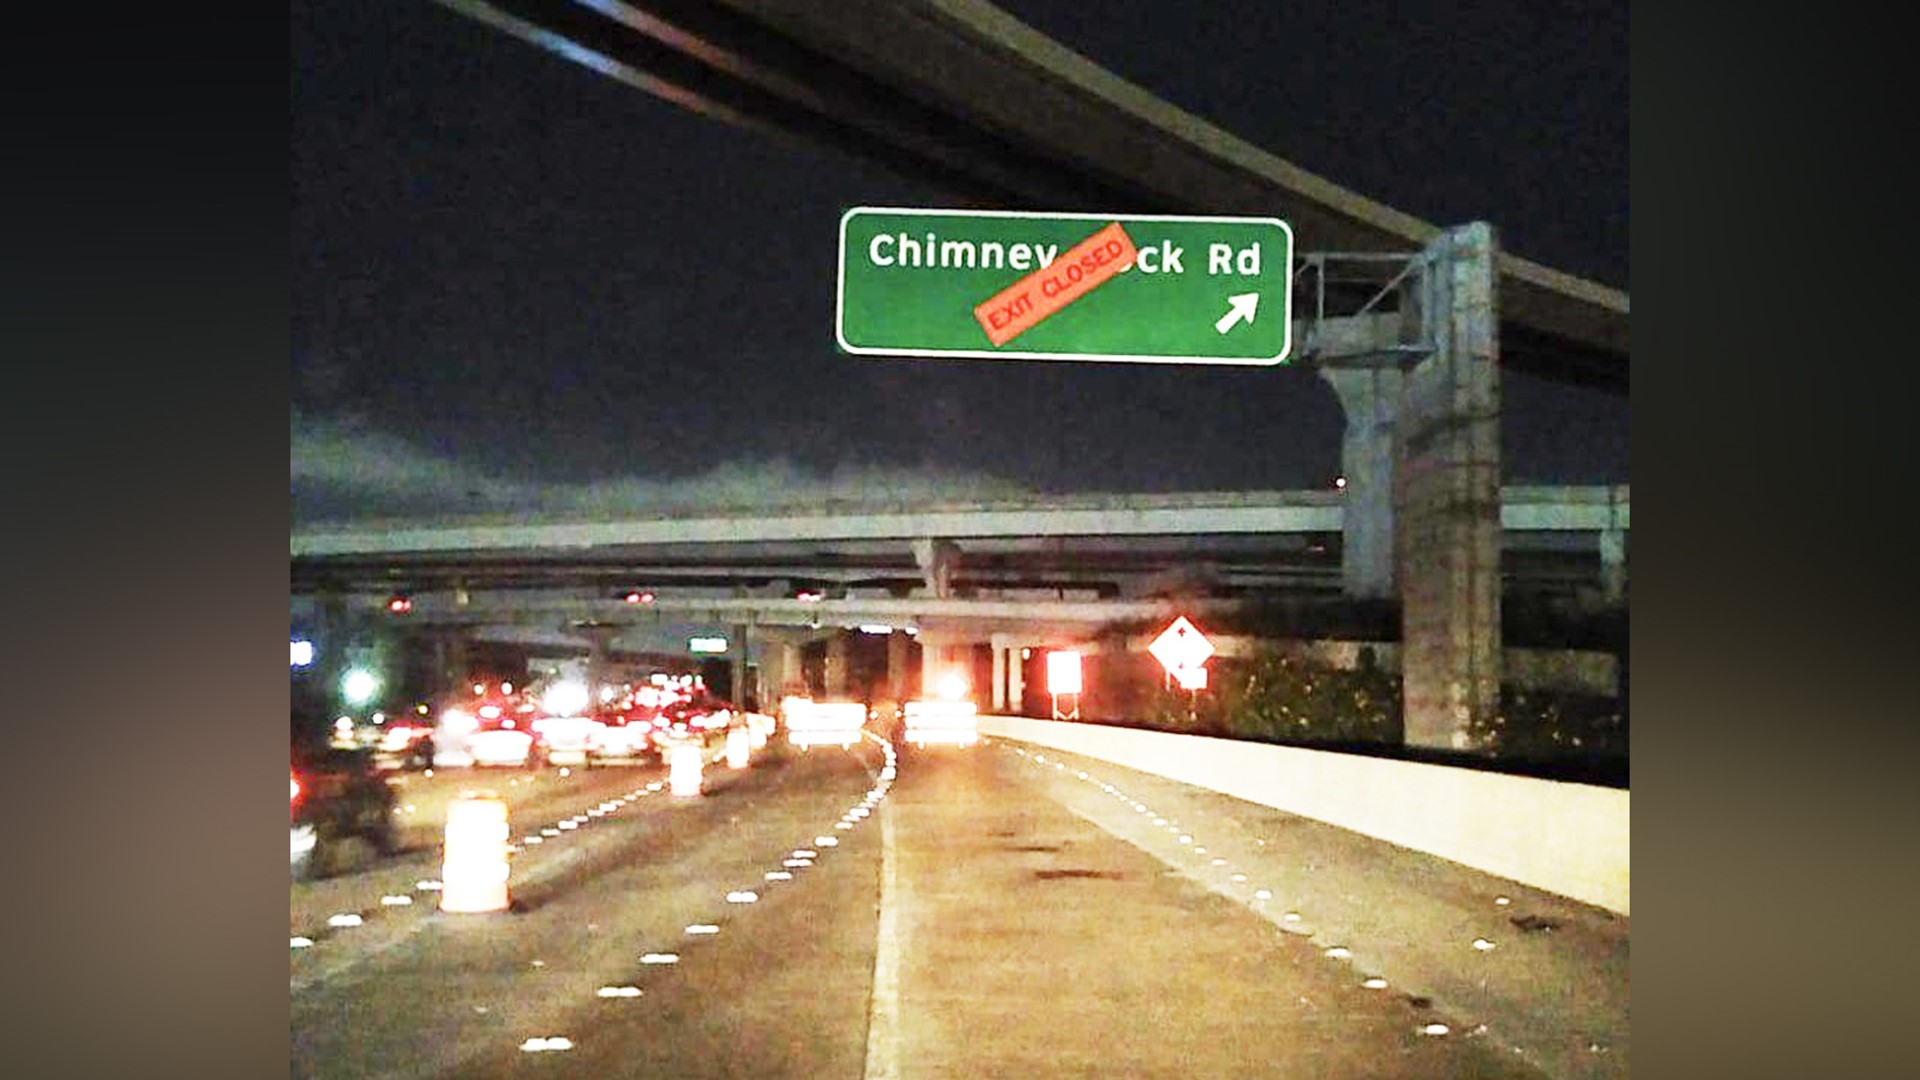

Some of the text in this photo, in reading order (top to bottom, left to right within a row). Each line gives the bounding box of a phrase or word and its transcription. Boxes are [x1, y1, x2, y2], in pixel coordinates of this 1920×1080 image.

[869, 233, 1261, 275] Chimney ck Rd
[987, 239, 1124, 331] EXIT CLOSED
